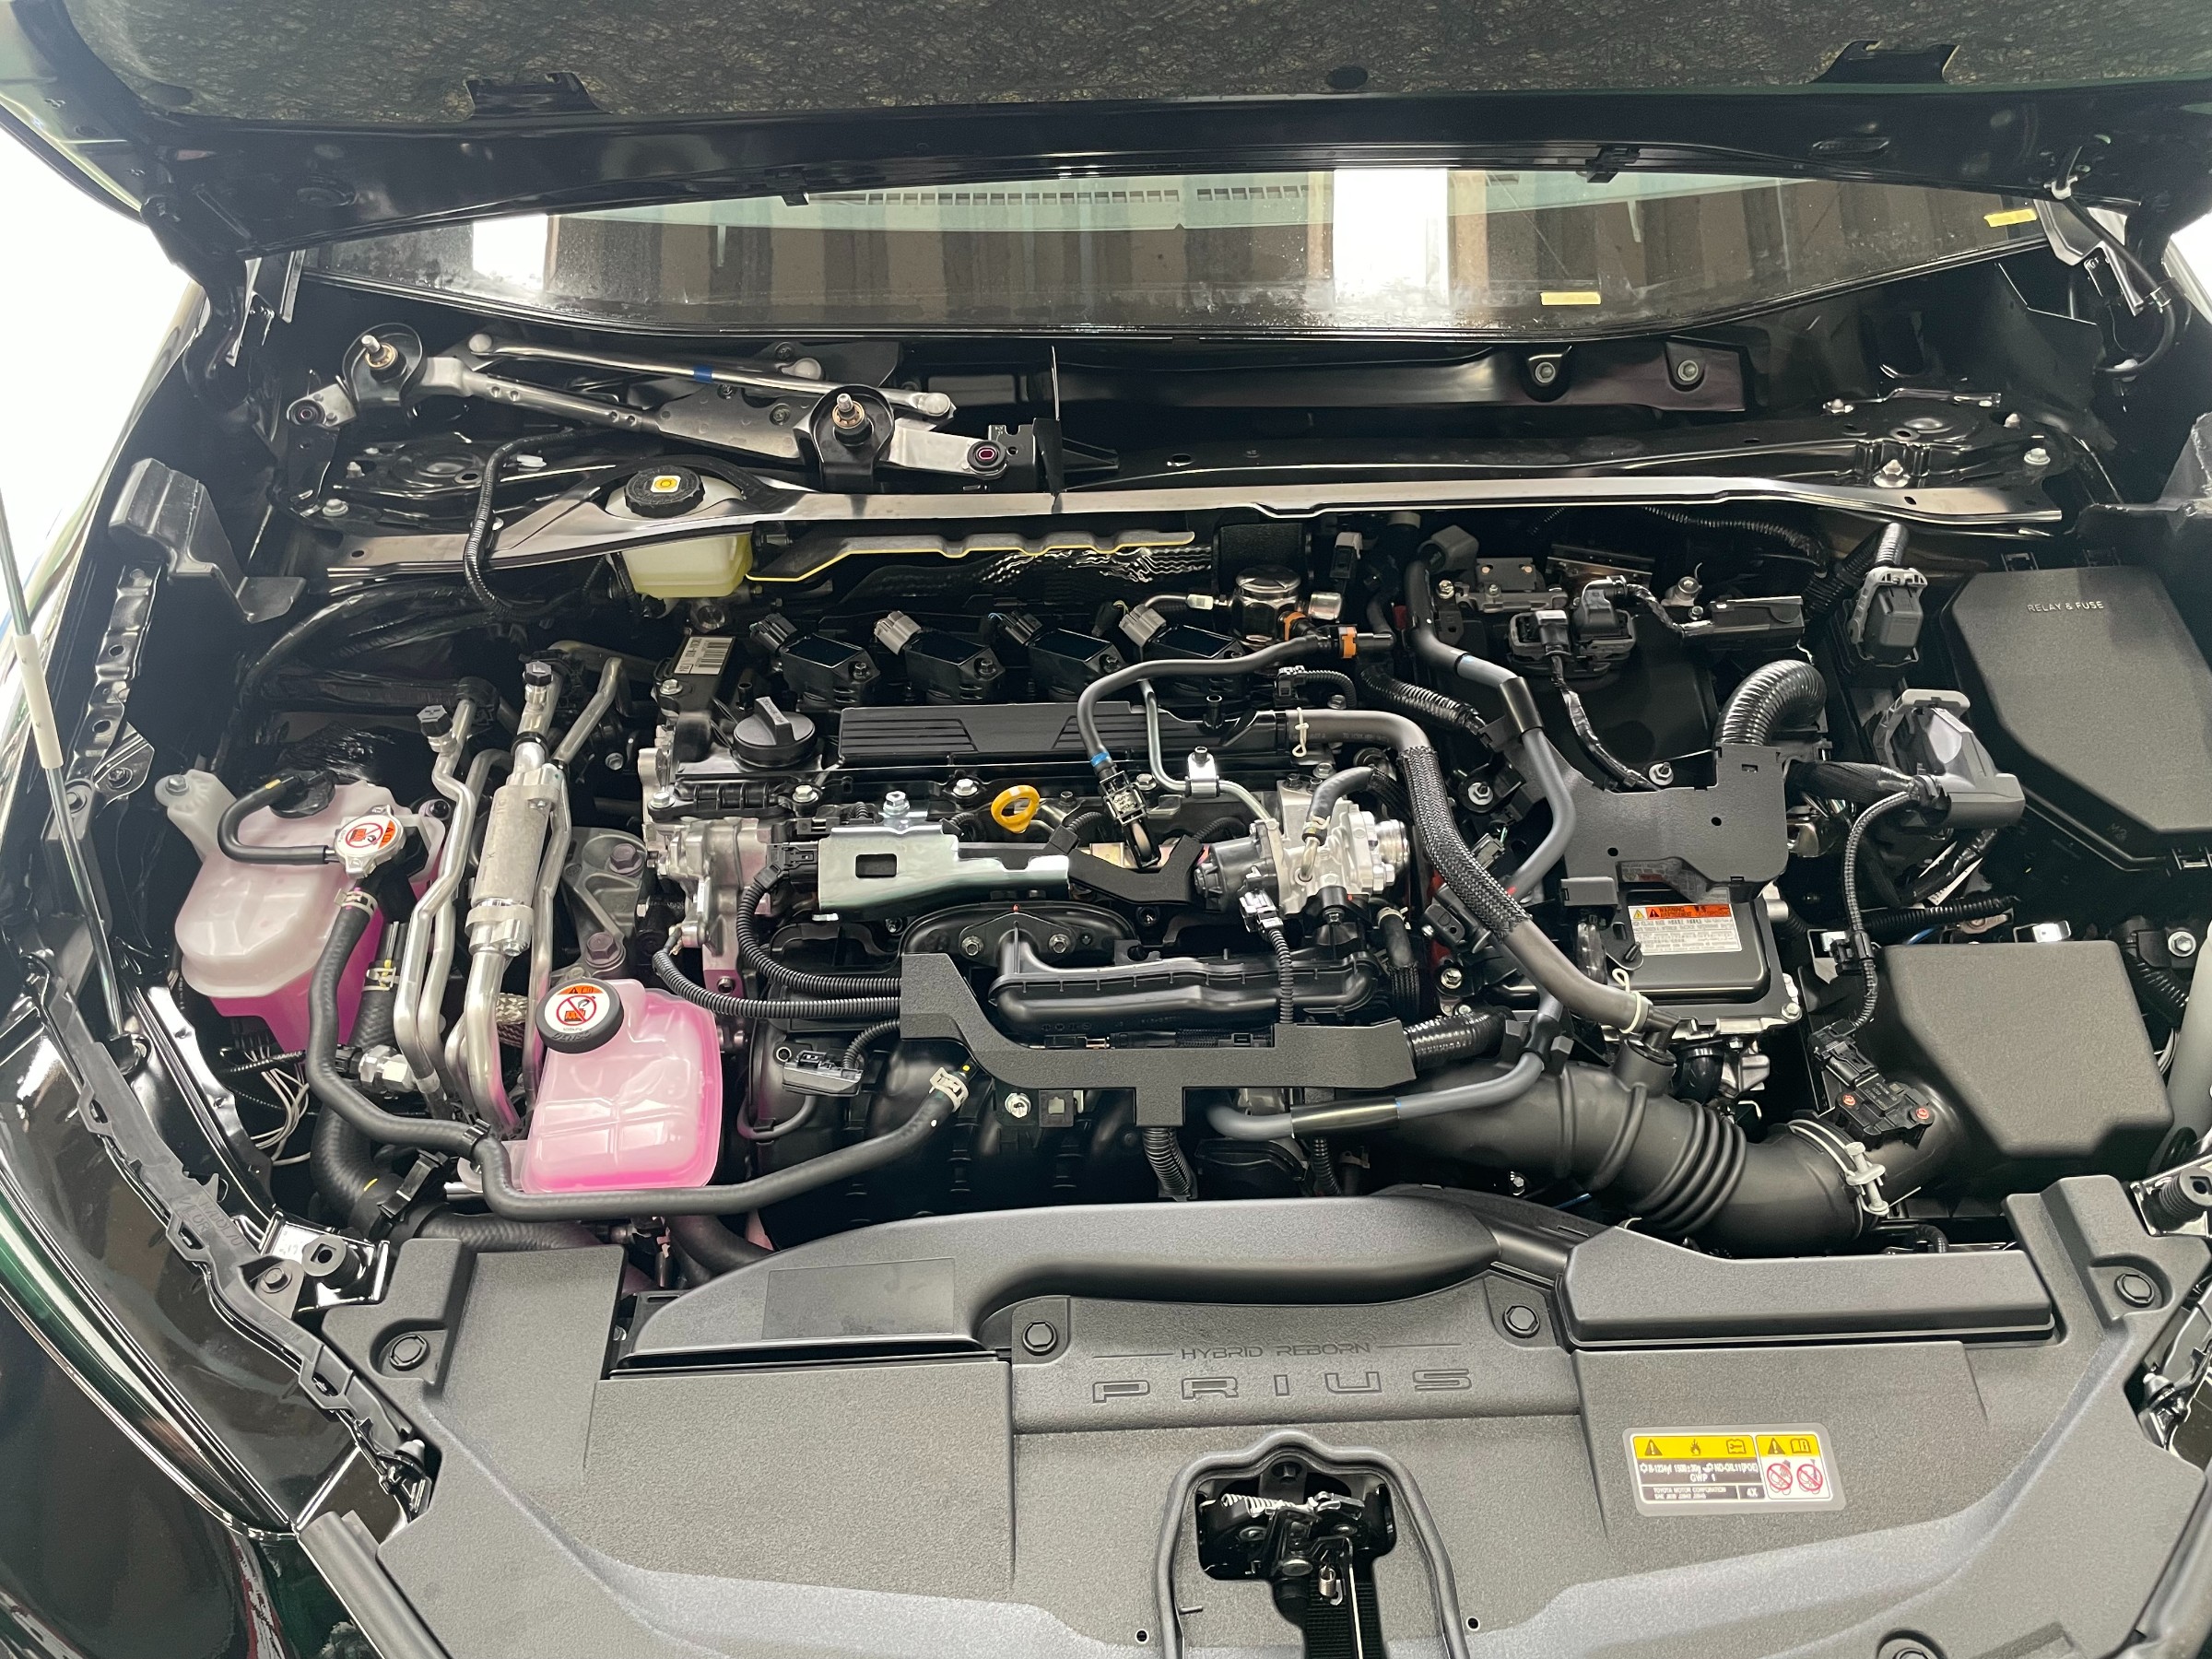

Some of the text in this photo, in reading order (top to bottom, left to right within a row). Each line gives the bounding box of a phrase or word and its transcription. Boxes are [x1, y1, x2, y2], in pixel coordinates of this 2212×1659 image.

[2027, 600, 2104, 612] RELAY & FUSE
[552, 1030, 591, 1041] DENSO
[1181, 1342, 1371, 1360] HYBRID REBORN
[1092, 1369, 1472, 1404] PRIUS
[1689, 1474, 1708, 1482] GWP
